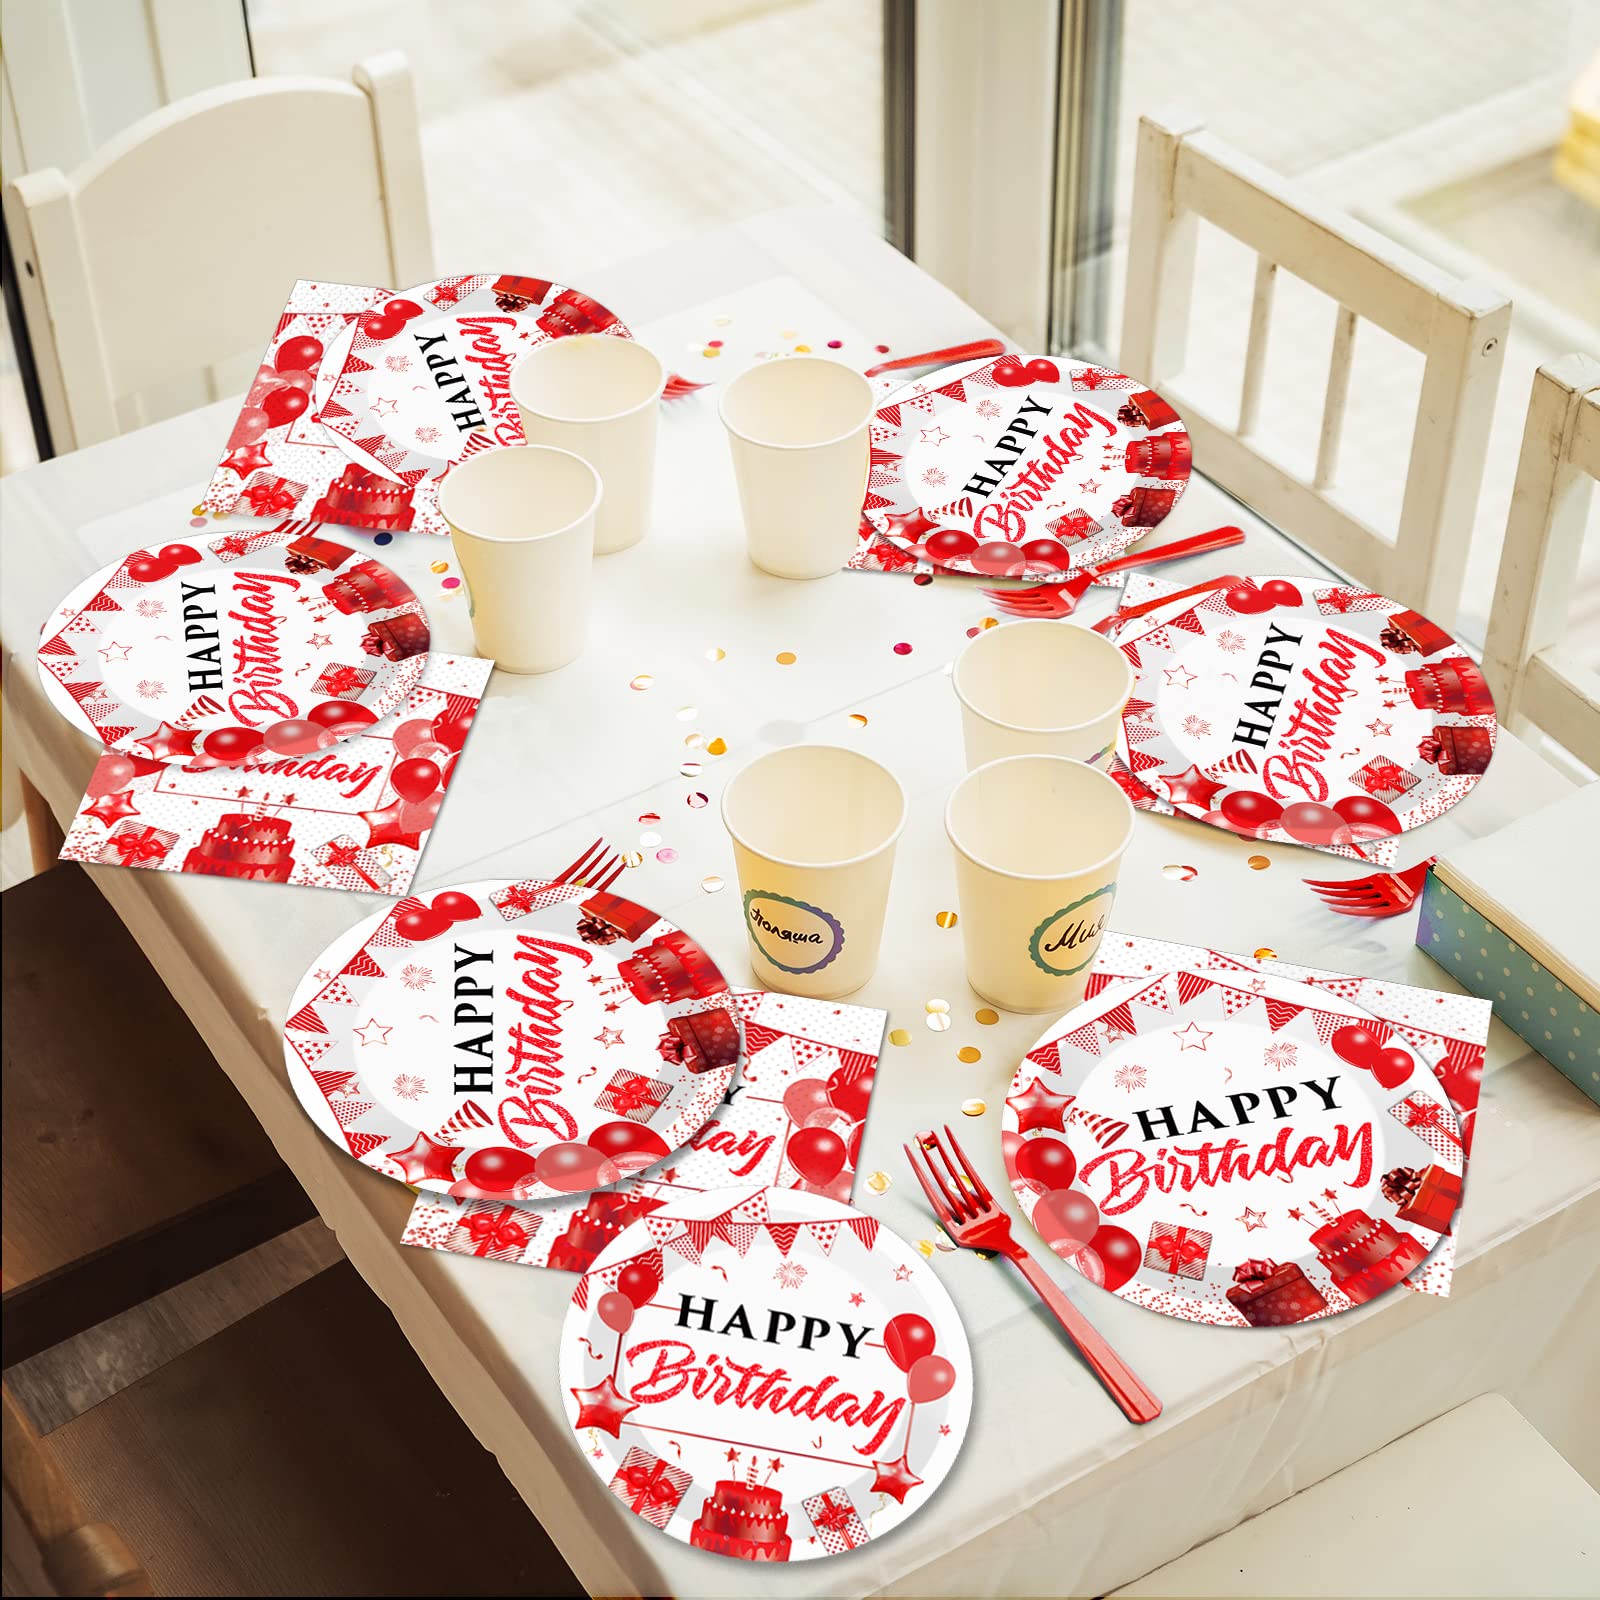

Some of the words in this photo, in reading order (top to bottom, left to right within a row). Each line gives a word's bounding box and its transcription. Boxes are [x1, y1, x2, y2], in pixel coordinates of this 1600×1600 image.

[413, 333, 487, 432] HAPPY
[961, 395, 1054, 499] HAPPY
[973, 402, 1118, 543] Birthday
[181, 581, 225, 692] HAPPY
[228, 571, 301, 727] Birthday
[1231, 621, 1303, 750] HAPPY
[1262, 627, 1387, 802] Birthday
[453, 942, 494, 1096] HAPPY
[497, 933, 593, 1150] Birthday
[1131, 1075, 1343, 1143] HAPPY
[1078, 1121, 1374, 1217] Birthday
[674, 1292, 875, 1359] HAPPY
[625, 1339, 907, 1456] Birthday
